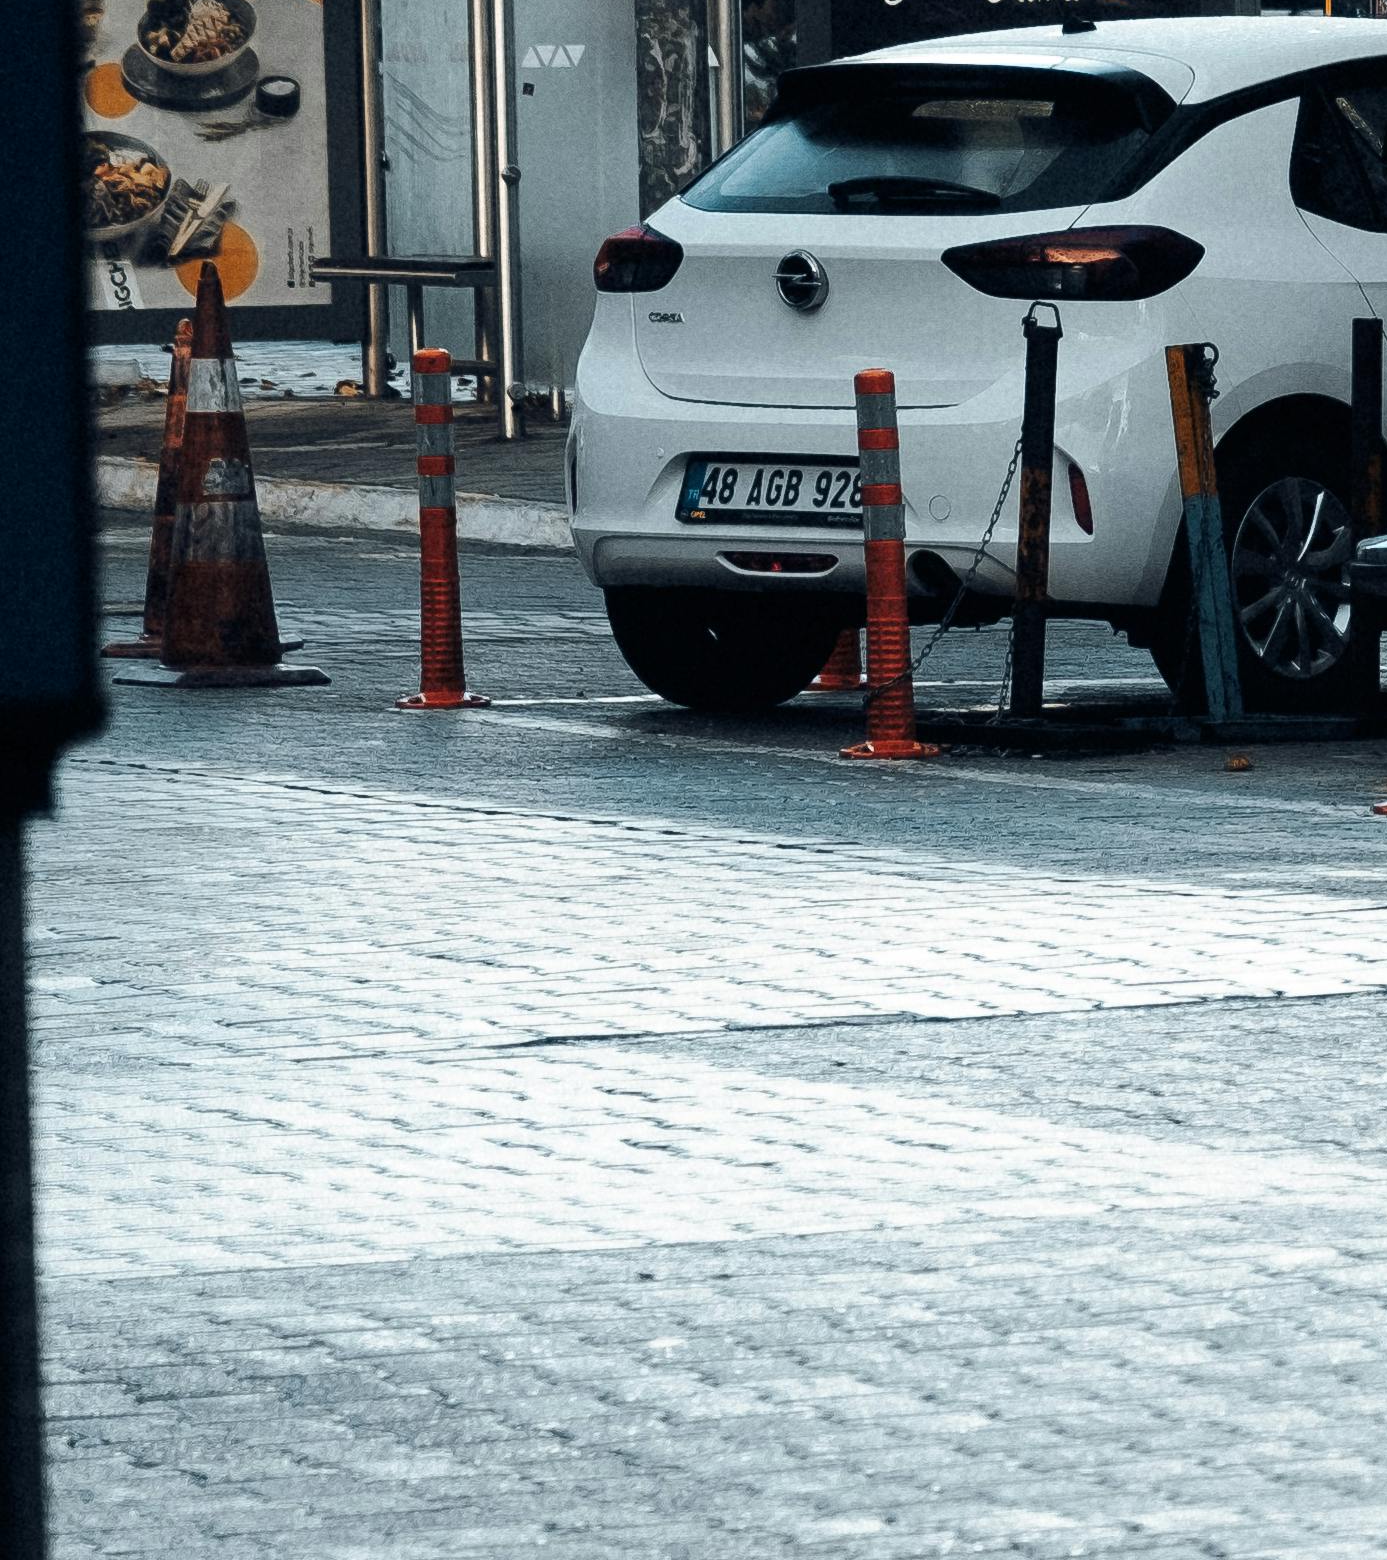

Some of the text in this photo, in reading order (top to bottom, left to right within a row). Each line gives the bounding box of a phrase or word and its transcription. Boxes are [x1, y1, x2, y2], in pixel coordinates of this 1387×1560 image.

[688, 489, 699, 500] TR
[701, 467, 738, 504] 48
[746, 468, 803, 506] AGB
